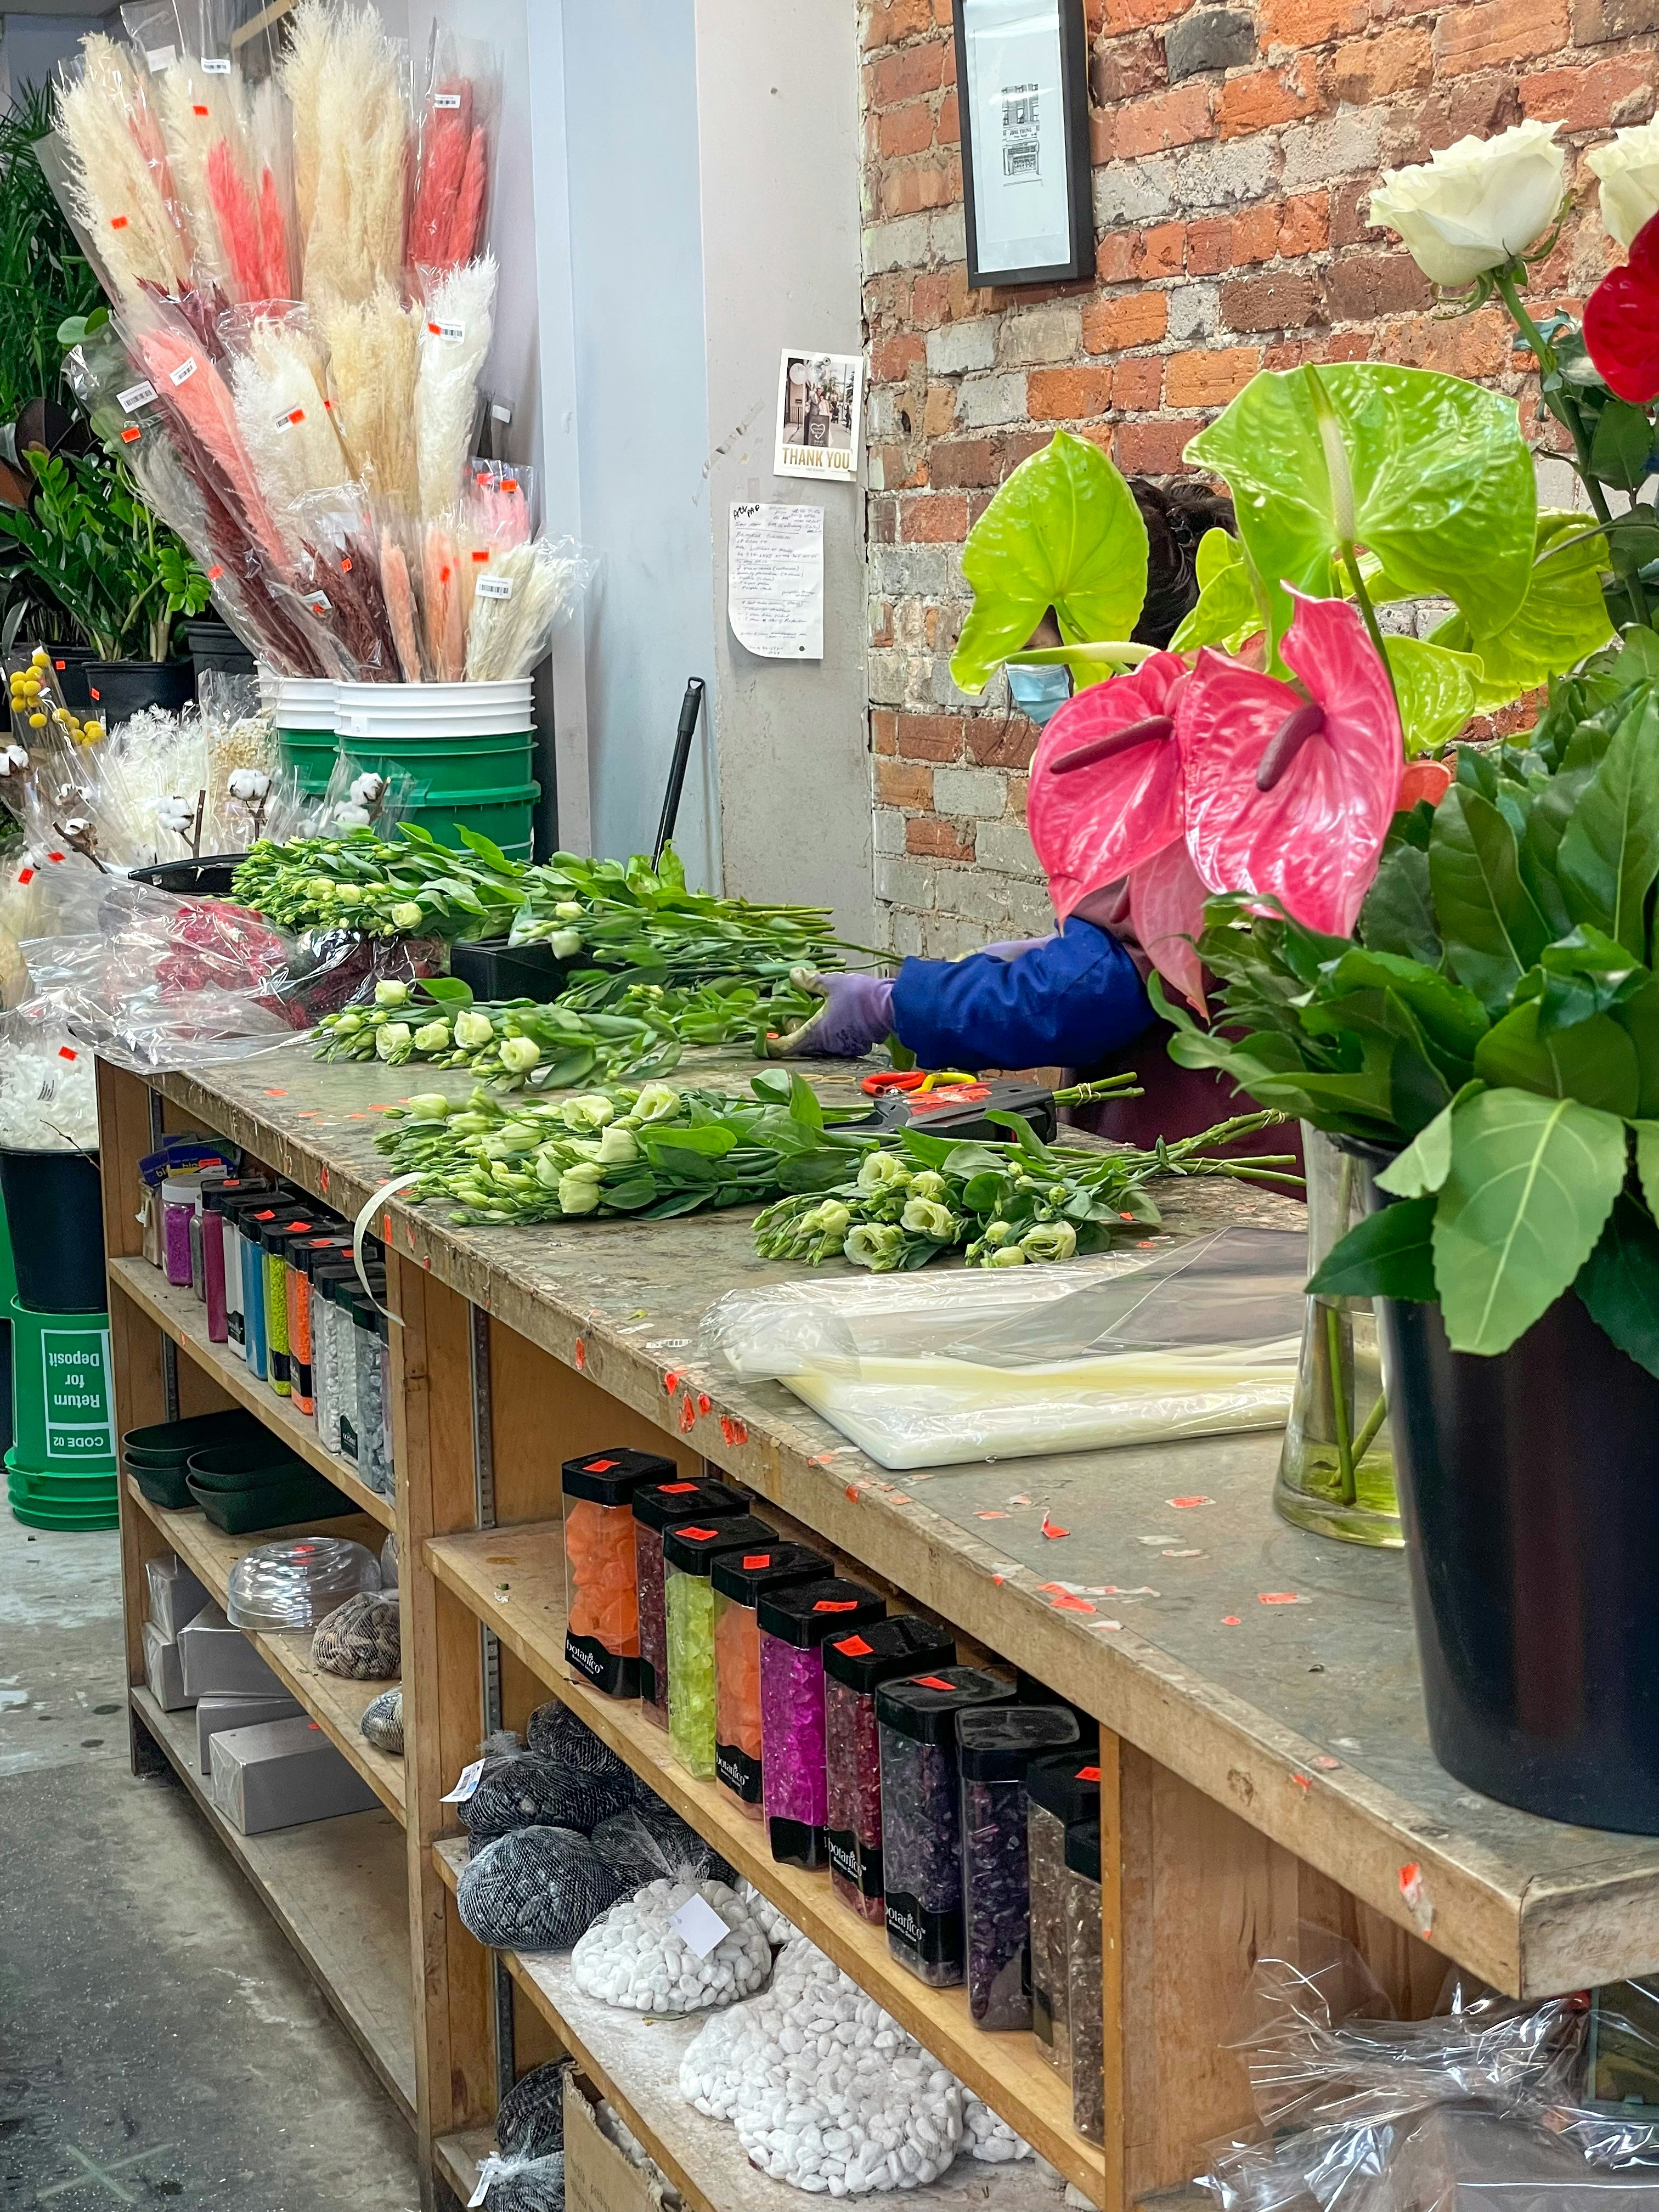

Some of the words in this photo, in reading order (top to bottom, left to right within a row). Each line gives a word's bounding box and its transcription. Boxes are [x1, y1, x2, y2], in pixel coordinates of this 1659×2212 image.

[782, 447, 823, 467] THANK
[827, 451, 850, 469] YOU
[48, 1351, 100, 1367] Deposit
[65, 1375, 84, 1388] for
[54, 1395, 100, 1408] Return
[53, 1437, 65, 1447] 02
[67, 1437, 104, 1447] CODE
